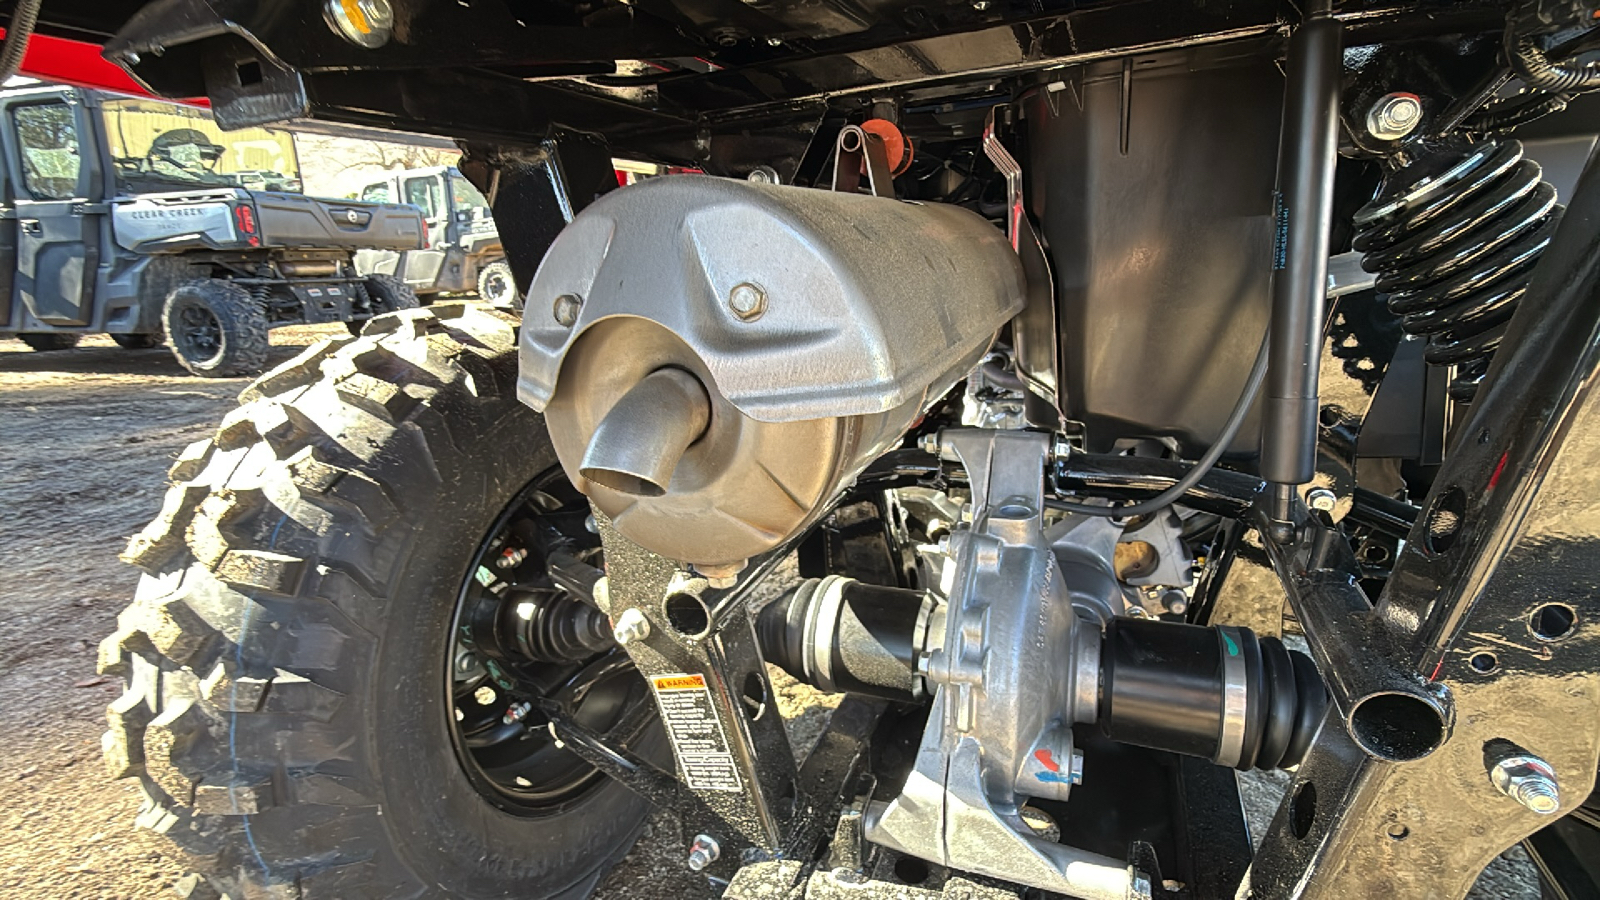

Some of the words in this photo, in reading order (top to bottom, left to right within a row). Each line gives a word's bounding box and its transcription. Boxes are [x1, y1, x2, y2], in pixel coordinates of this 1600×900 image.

[131, 210, 164, 219] CLEAR
[169, 208, 203, 217] CREEK
[666, 677, 704, 686] WARNING
